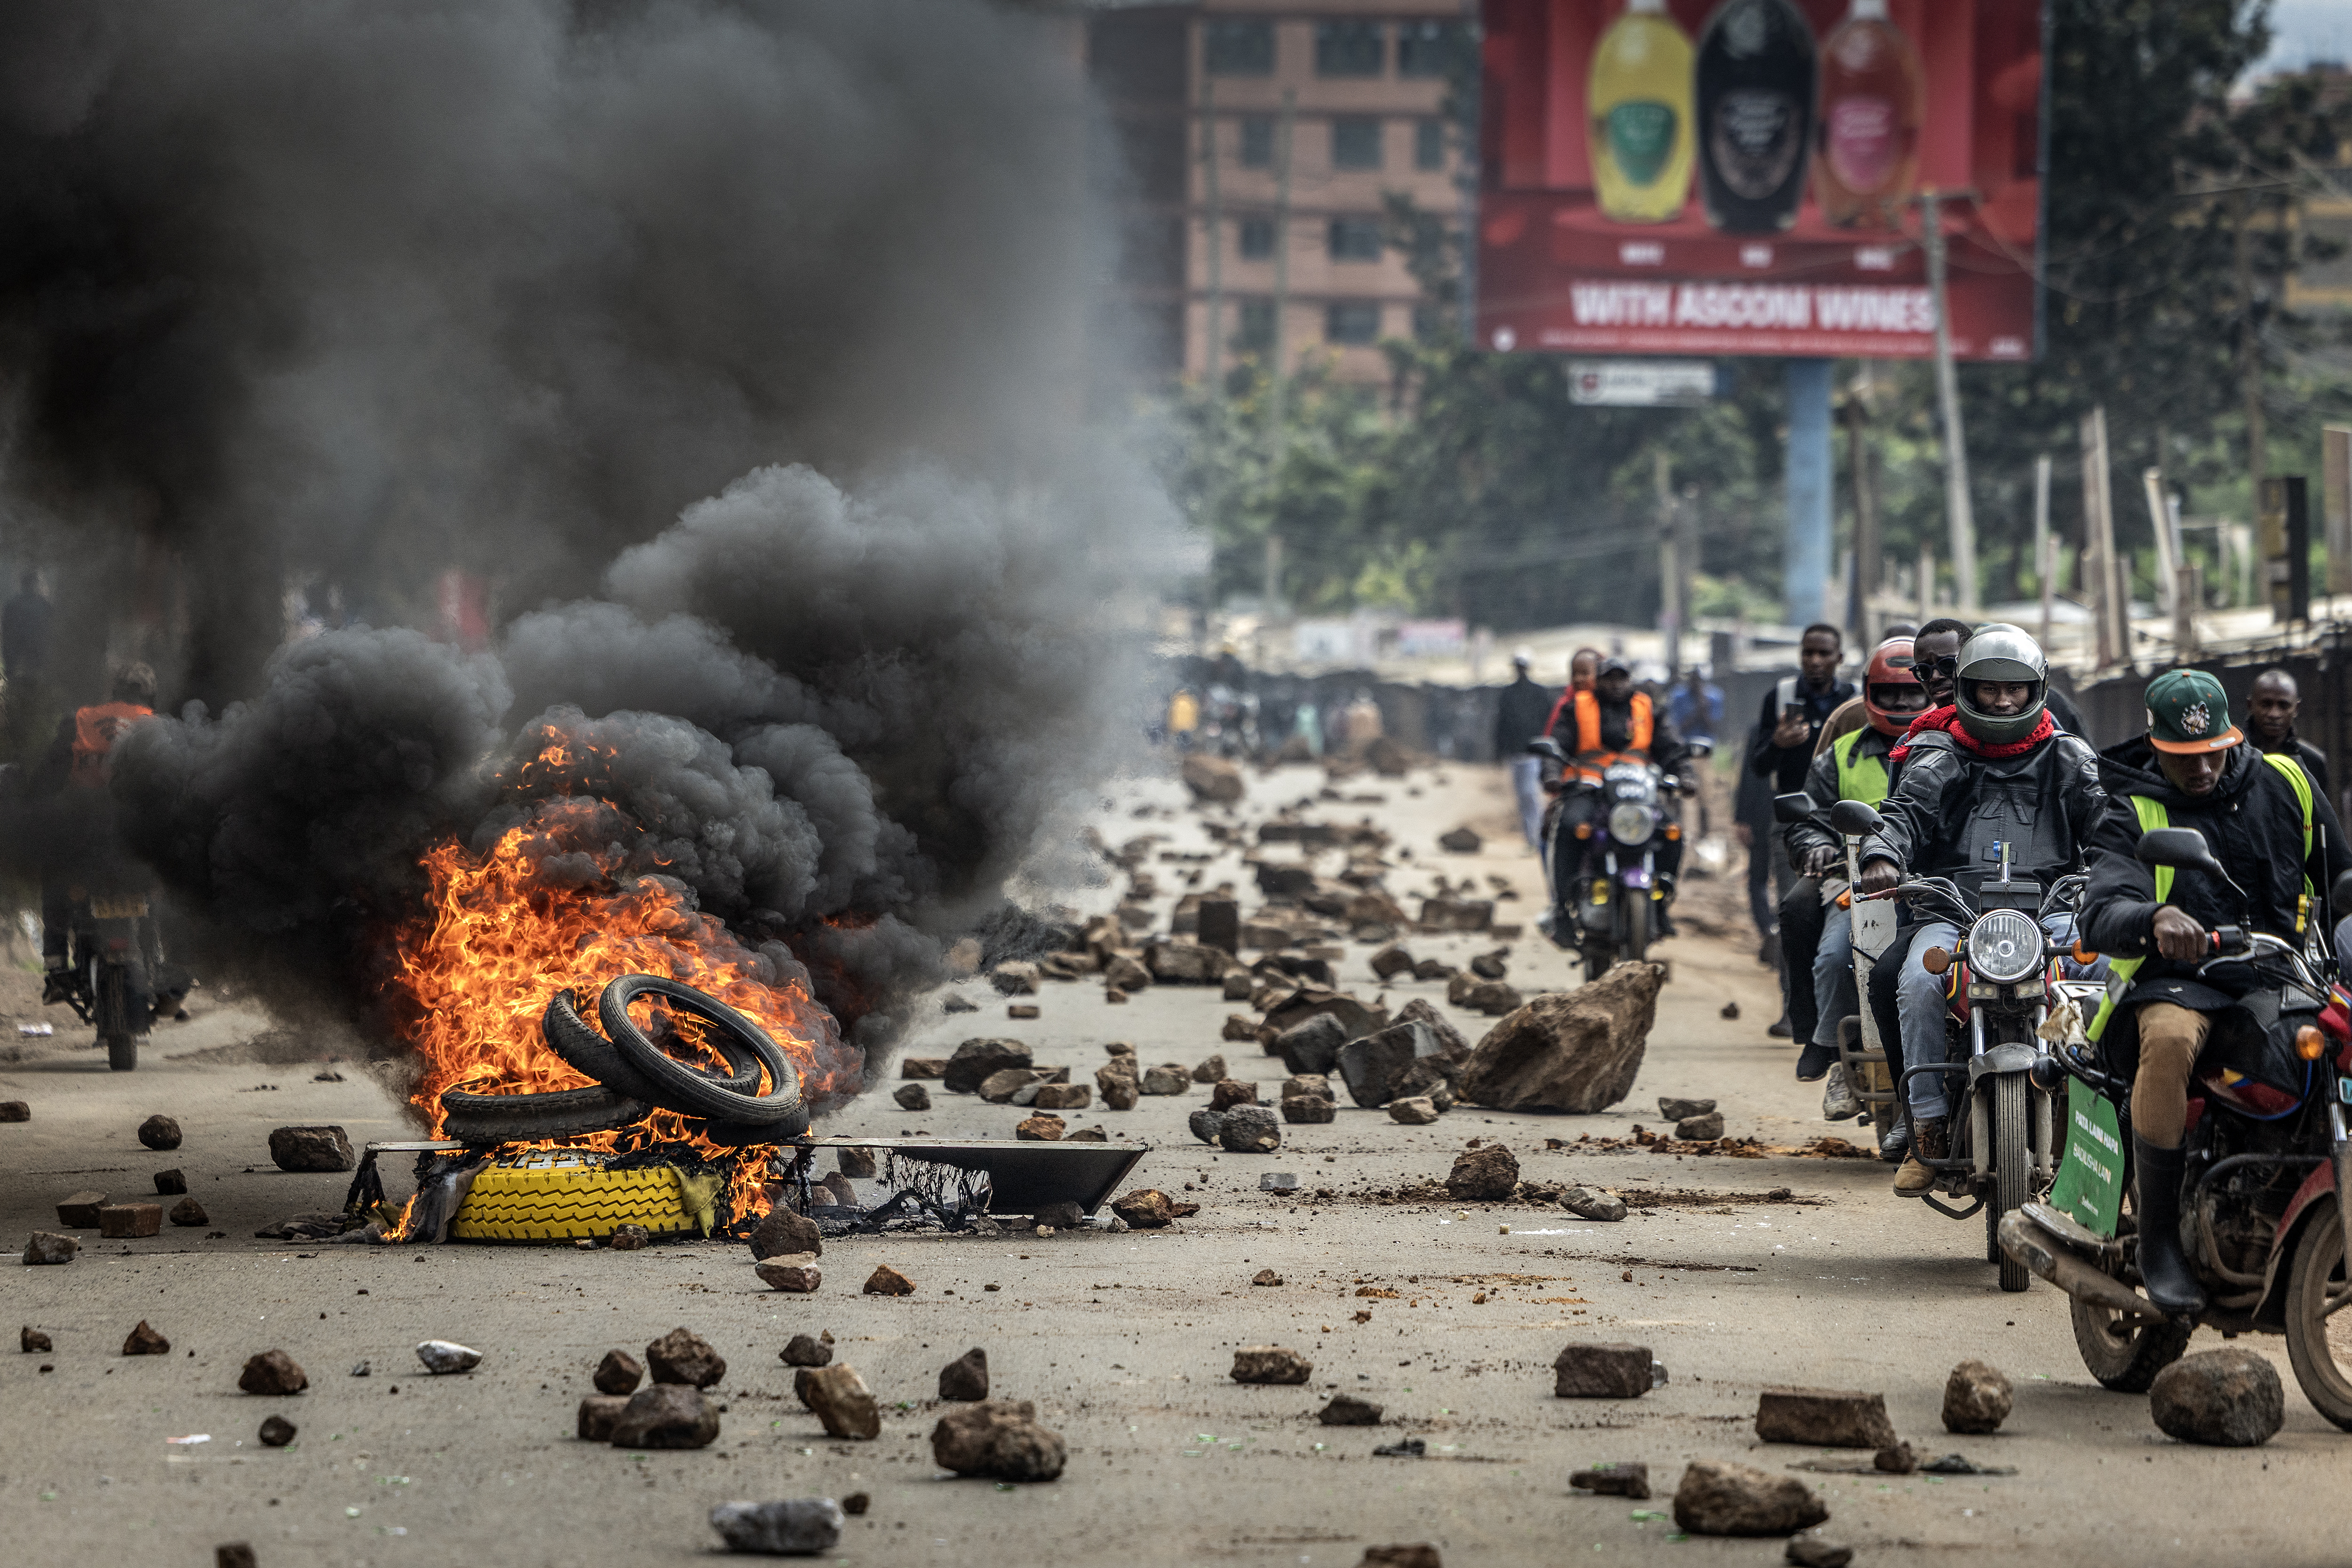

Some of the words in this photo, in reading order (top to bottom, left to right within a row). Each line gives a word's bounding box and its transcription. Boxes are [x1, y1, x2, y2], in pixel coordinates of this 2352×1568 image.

[1571, 284, 1669, 325] WITH
[1816, 288, 1934, 332] WINES
[2075, 1109, 2089, 1132] PATA
[2089, 1120, 2104, 1144] LAINI
[2103, 1132, 2118, 1156] HAPA
[2073, 1142, 2098, 1175] BADILISHA
